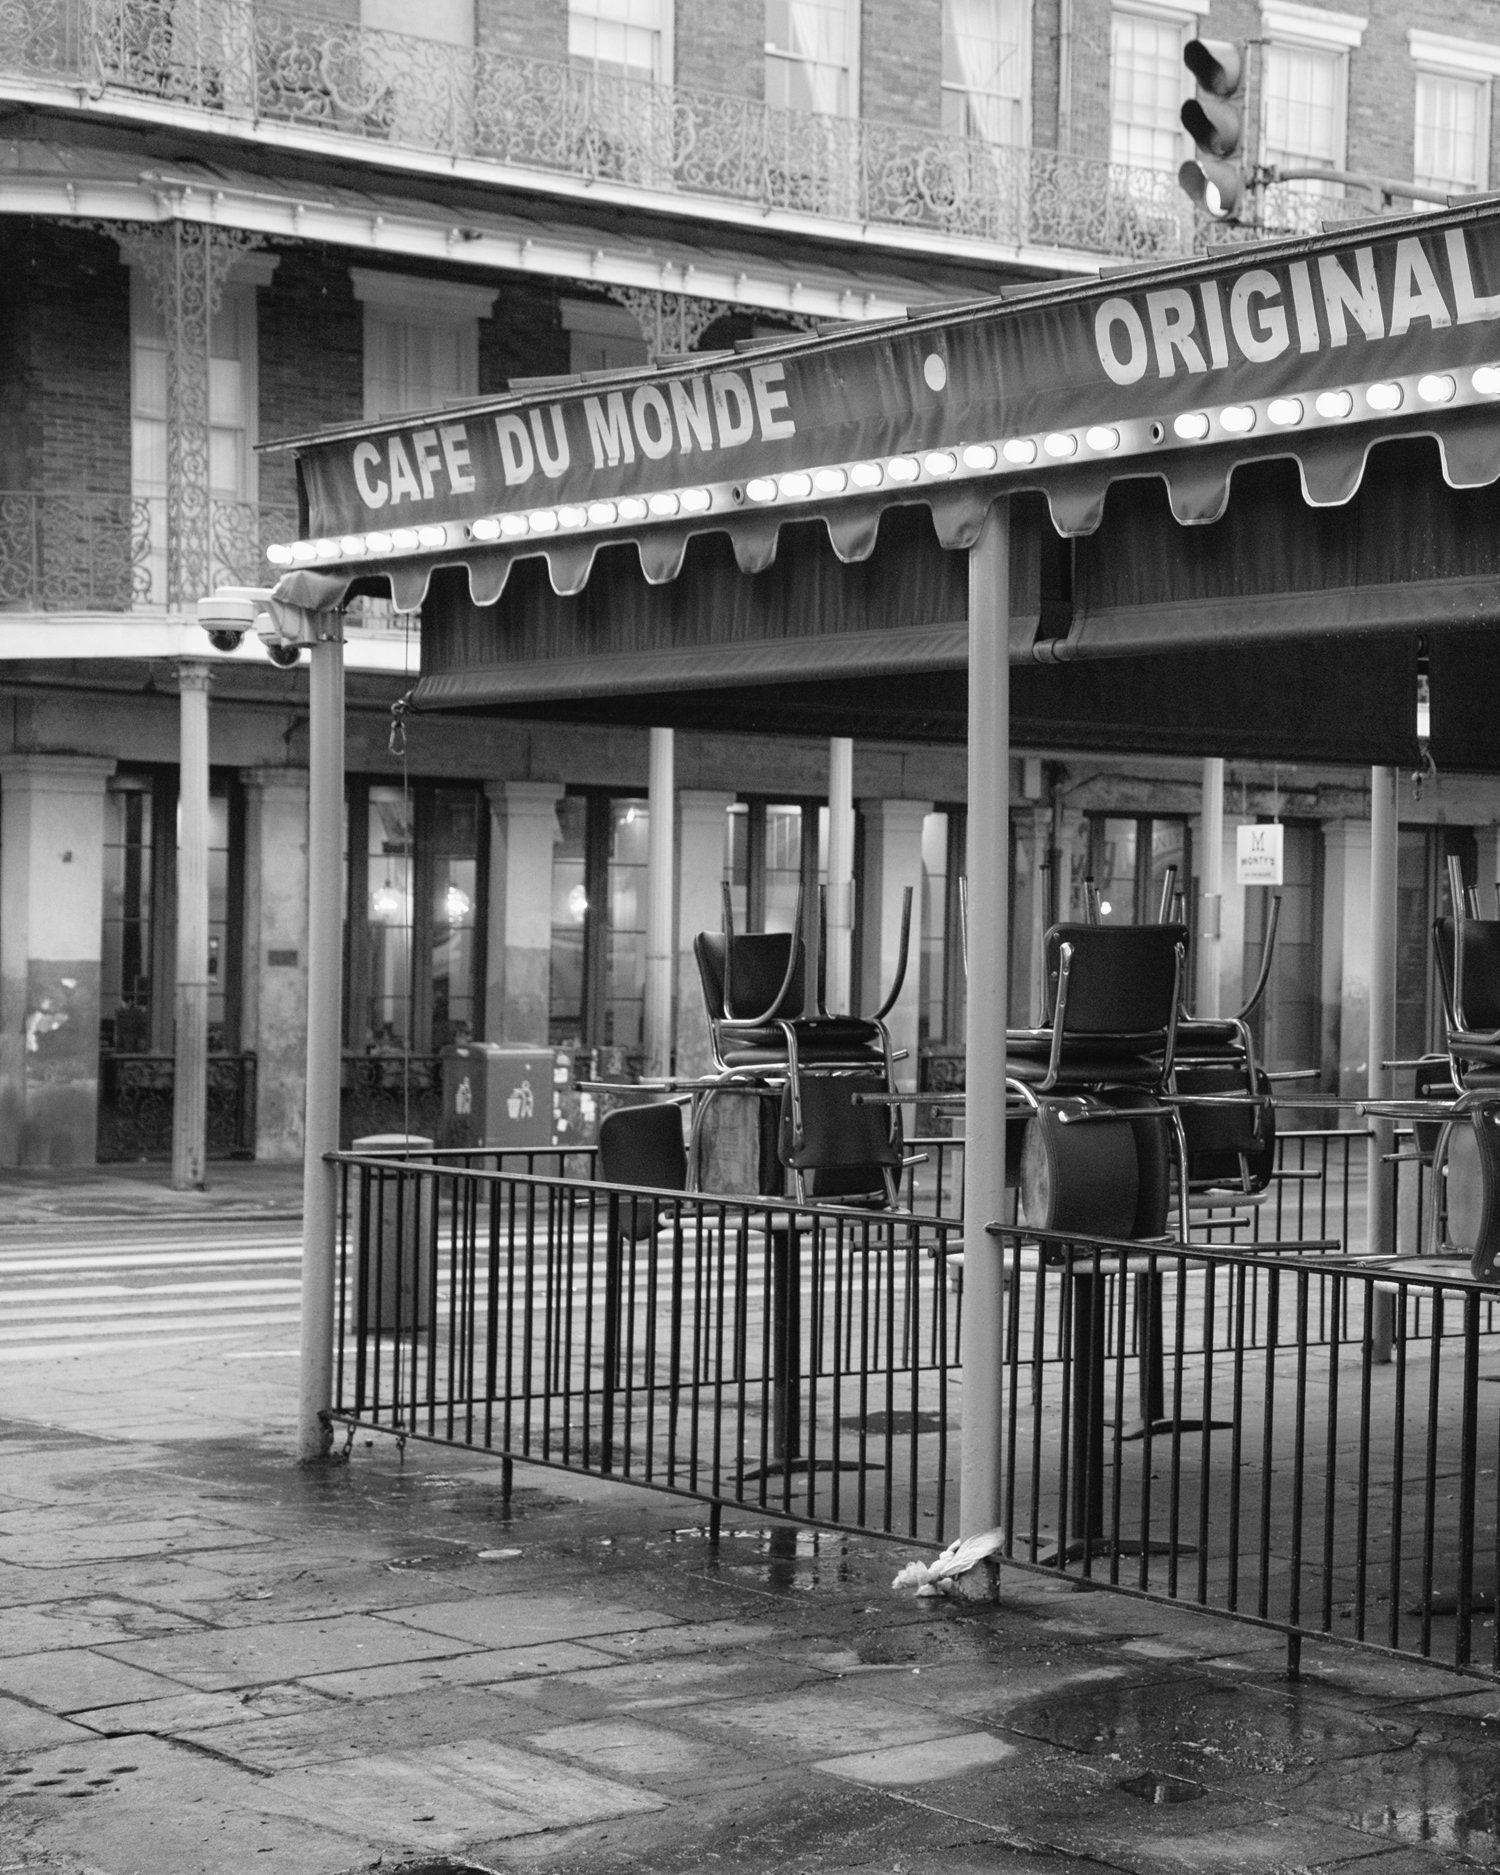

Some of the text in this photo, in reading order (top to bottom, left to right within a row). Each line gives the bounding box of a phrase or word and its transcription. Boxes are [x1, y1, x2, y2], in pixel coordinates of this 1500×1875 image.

[1095, 228, 1500, 385] ORIGINAL
[352, 362, 796, 509] CAFE DU MONDE
